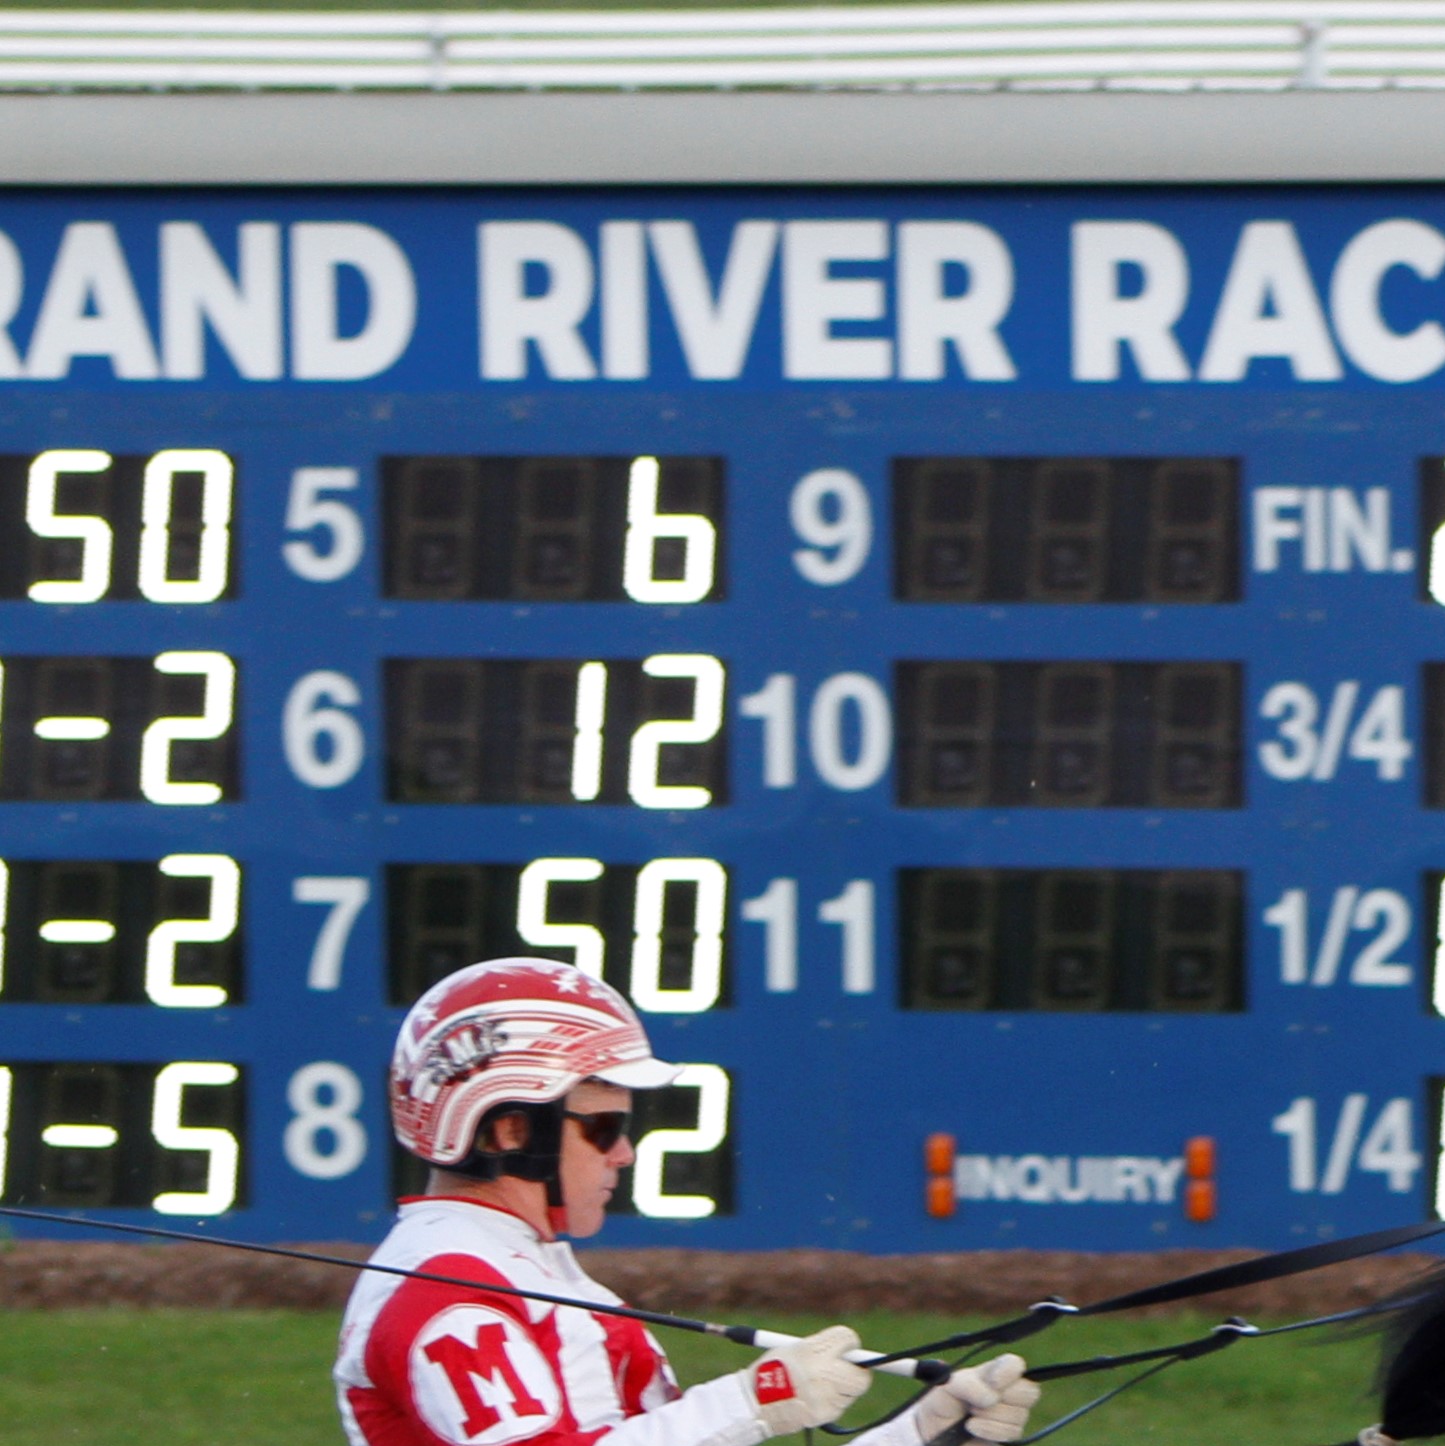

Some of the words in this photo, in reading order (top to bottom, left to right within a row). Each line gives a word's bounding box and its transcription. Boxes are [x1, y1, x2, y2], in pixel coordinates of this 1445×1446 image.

[0, 220, 416, 381] AND
[476, 219, 1017, 381] RIVER
[26, 449, 233, 603] 50
[282, 467, 364, 582] 5
[622, 456, 716, 603] 6
[788, 468, 872, 585] 9
[1252, 486, 1415, 573] FIN.
[0, 651, 236, 805] -2
[282, 671, 364, 788] 6
[571, 653, 725, 809] 12
[739, 671, 893, 791] 10
[1258, 681, 1412, 781] 3/4
[0, 854, 240, 1008] -2
[293, 878, 370, 990] 7
[740, 878, 875, 994] 11
[1263, 886, 1413, 986] 1/2
[0, 1062, 239, 1215] -5
[283, 1062, 366, 1179] 8
[955, 1154, 1186, 1204] INQUIRY
[1272, 1094, 1422, 1194] 1/4
[423, 1322, 548, 1439] M
